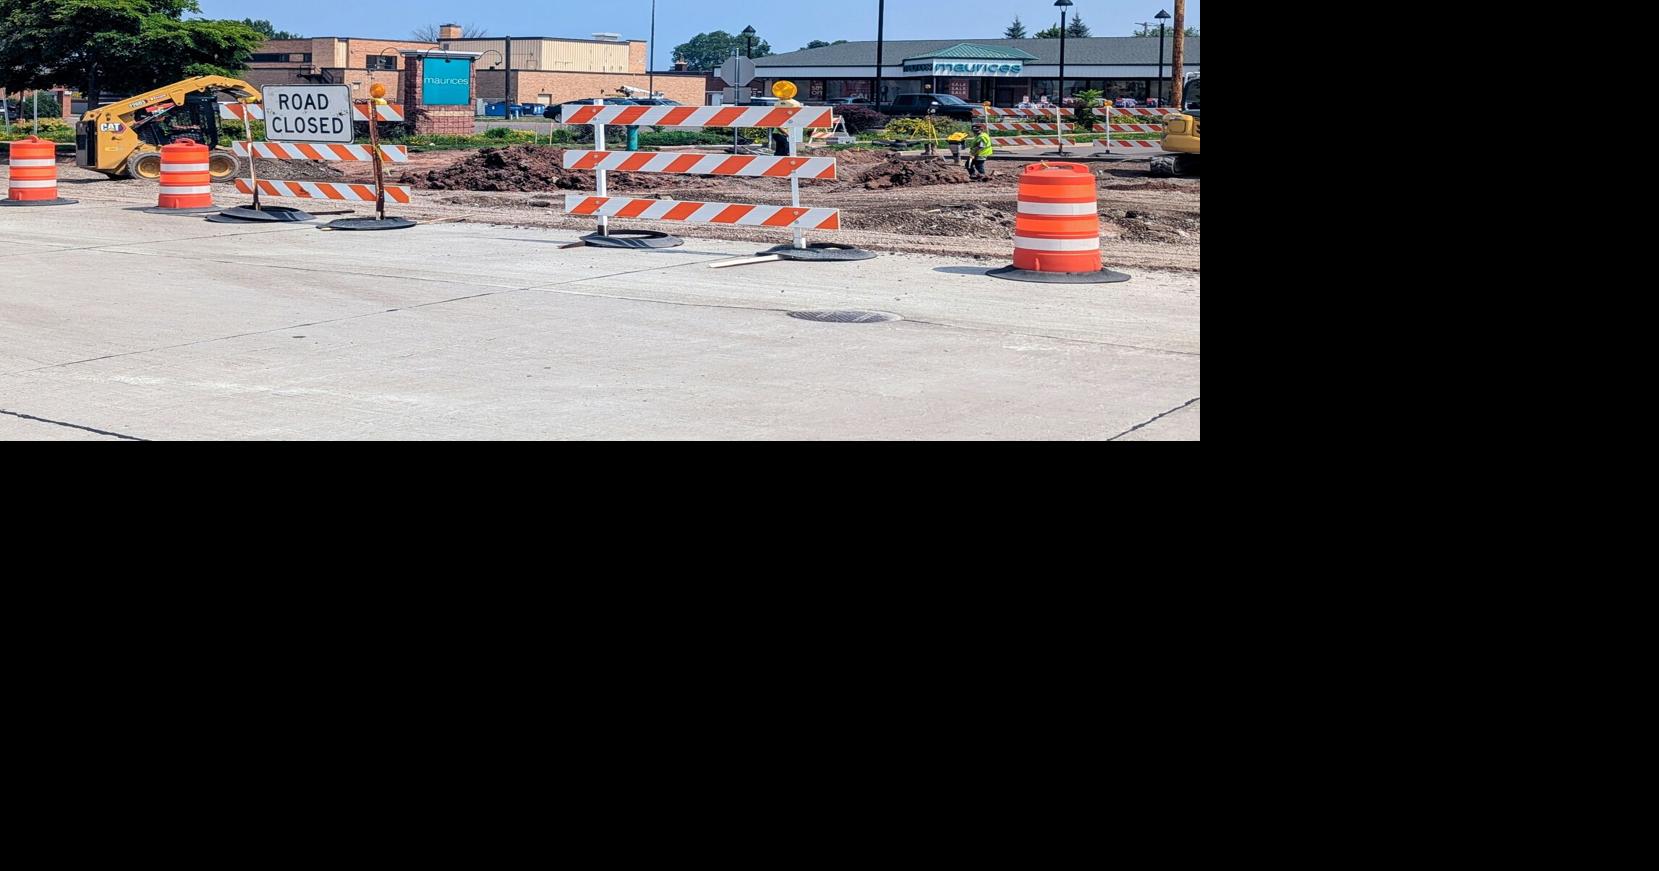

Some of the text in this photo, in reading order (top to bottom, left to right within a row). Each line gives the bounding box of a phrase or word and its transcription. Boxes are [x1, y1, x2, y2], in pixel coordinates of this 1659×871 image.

[934, 63, 1021, 73] maurices
[424, 77, 469, 85] maurices
[278, 93, 329, 110] ROAD
[100, 123, 121, 132] CAT
[272, 116, 344, 134] CLOSED
